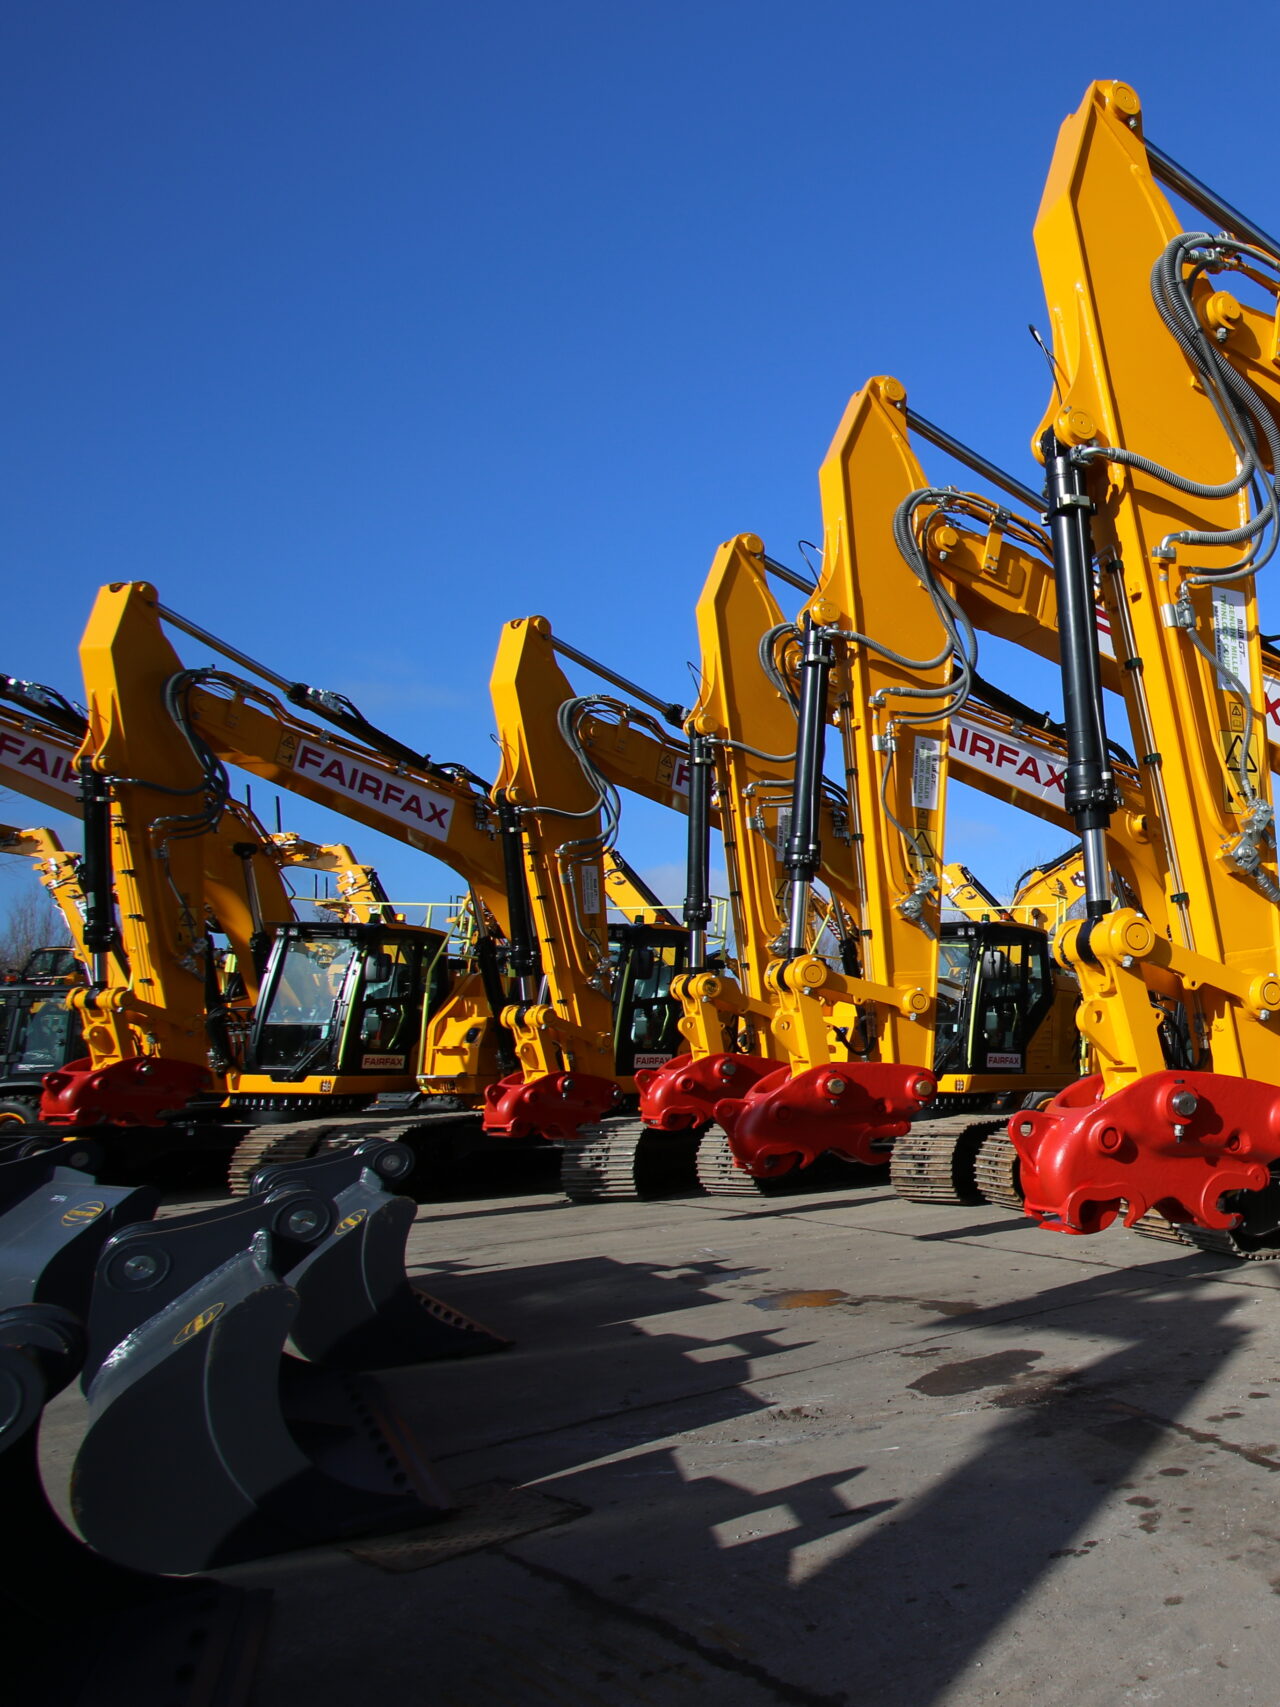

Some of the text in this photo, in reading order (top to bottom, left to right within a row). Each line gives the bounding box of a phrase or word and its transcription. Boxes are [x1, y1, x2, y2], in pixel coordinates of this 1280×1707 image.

[1220, 594, 1229, 641] TWINLOCK
[1229, 603, 1238, 644] GENUINE
[298, 745, 449, 829] FAIRFAX
[364, 1057, 403, 1066] FAIRFAX
[988, 1056, 1020, 1065] FAIRFAX
